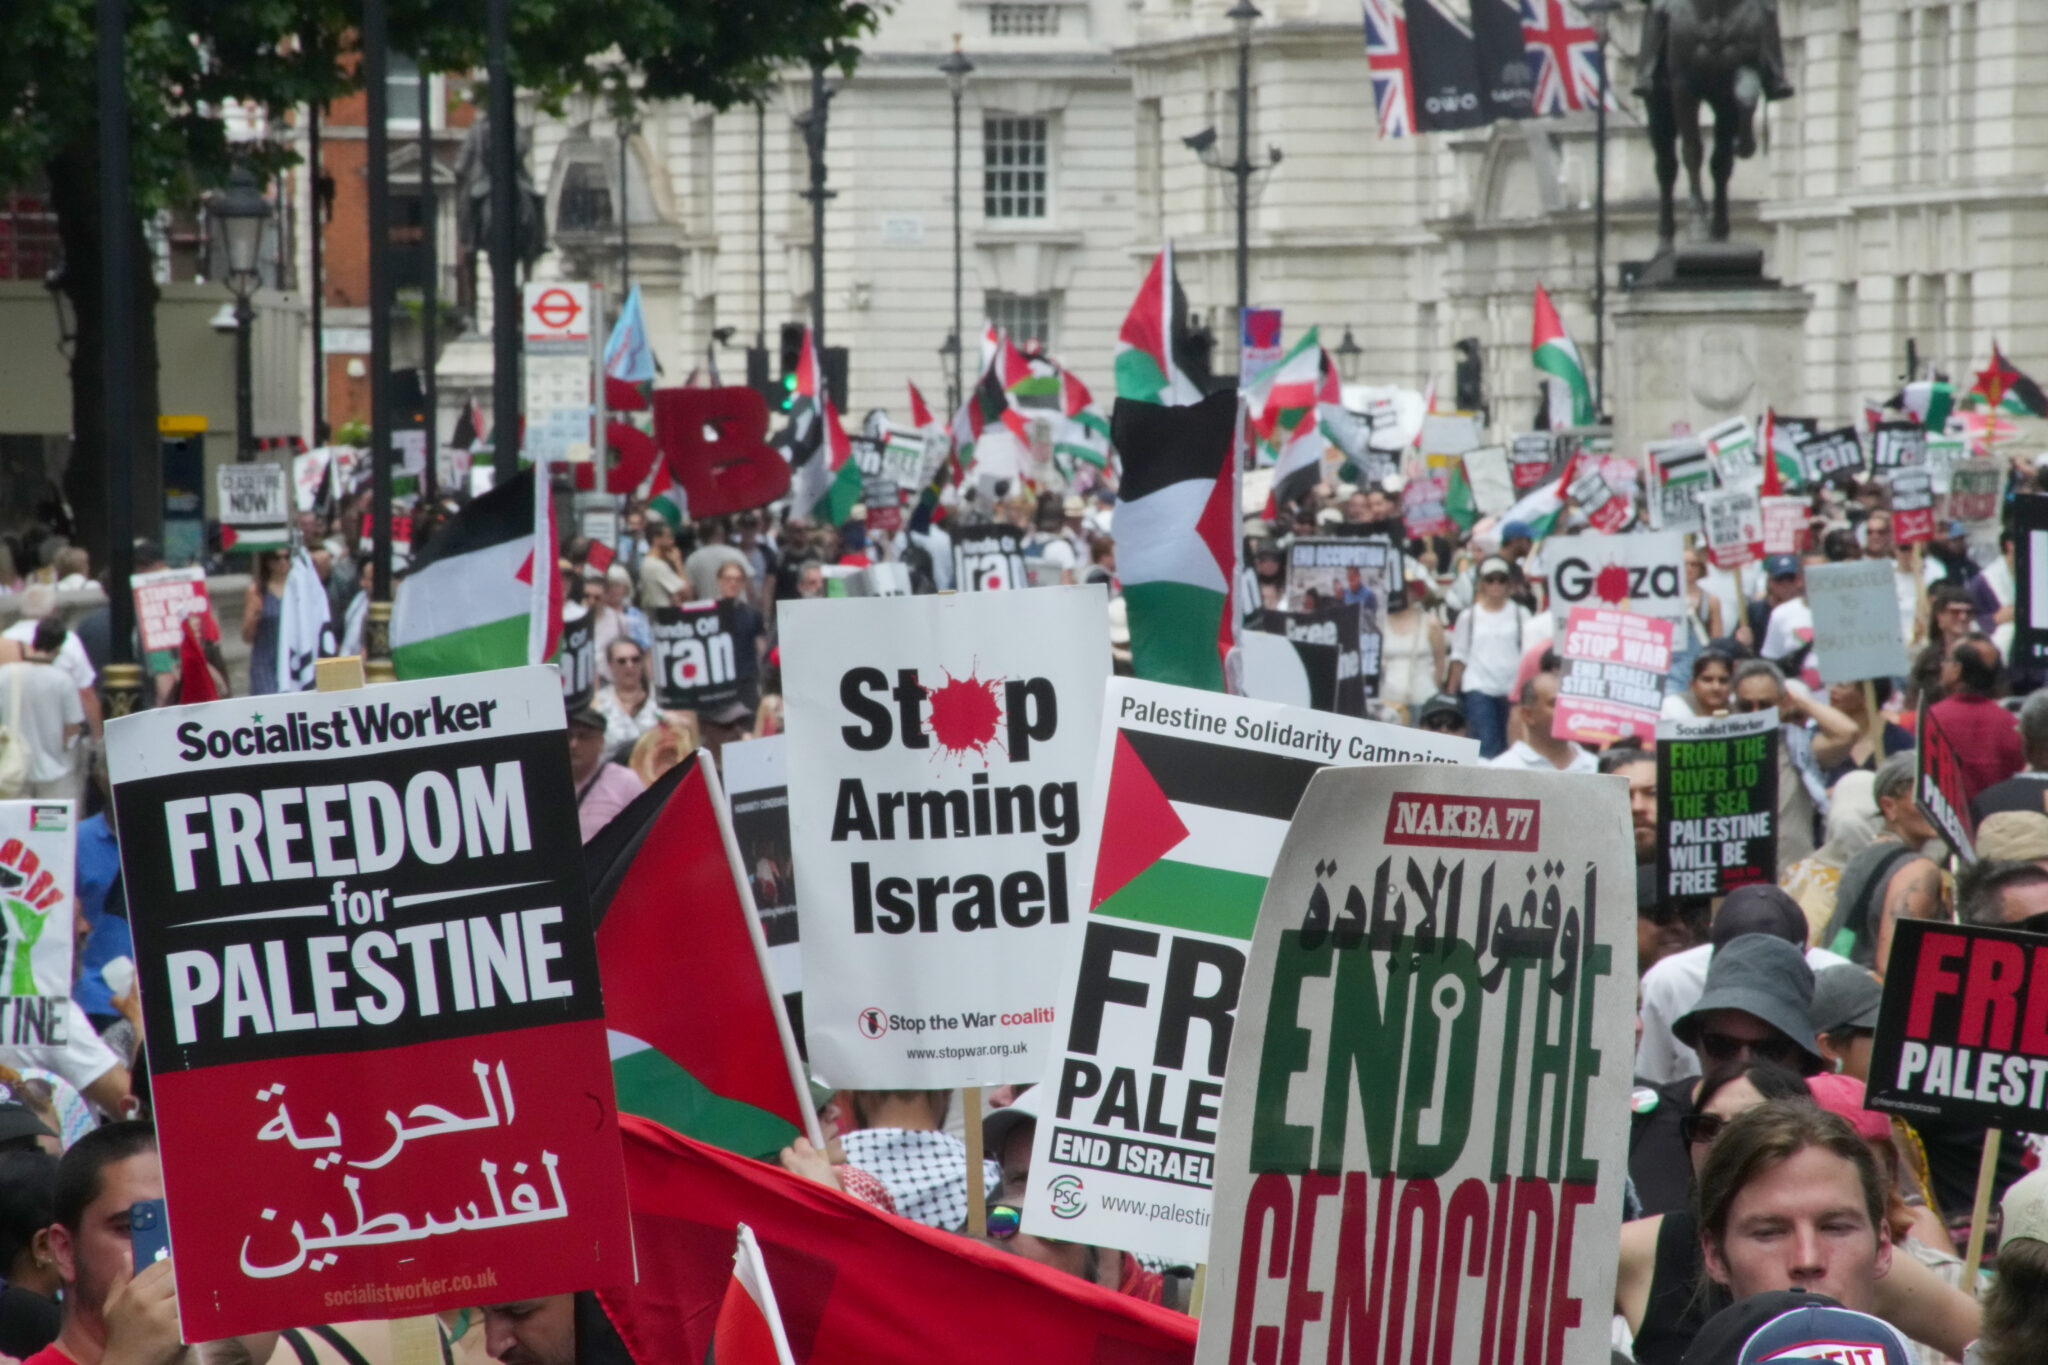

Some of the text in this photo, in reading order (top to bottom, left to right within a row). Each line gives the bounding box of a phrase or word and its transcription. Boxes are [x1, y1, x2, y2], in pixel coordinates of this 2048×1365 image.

[1554, 557, 1680, 602] Gza
[654, 632, 736, 689] ran
[1567, 632, 1668, 668] STOP WAR
[1562, 675, 1606, 698] STATE
[839, 665, 1058, 763] Stp
[1120, 695, 1227, 736] Palestine
[1233, 716, 1342, 759] Solidarity
[1669, 735, 1766, 767] FROM THE
[1670, 763, 1758, 793] RIVER TO
[830, 772, 1081, 847] Arming
[1393, 801, 1534, 841] NAKBA 77
[1672, 790, 1749, 818] THE SEA
[164, 760, 532, 892] FREEDOM
[1669, 811, 1771, 845] PALESTINE
[1669, 840, 1747, 870] WILL BE
[330, 880, 389, 926] for
[850, 851, 1070, 934] Israel
[1668, 869, 1717, 896] FREE
[165, 906, 574, 1045] PALESTINE
[889, 1014, 927, 1033] Stop
[929, 1015, 959, 1030] the
[962, 1011, 997, 1028] War
[906, 1041, 1028, 1061] www.stopwar.org.uk
[1249, 929, 1613, 1185] END THE
[256, 1058, 517, 1170] الحرية
[1053, 1132, 1111, 1167] END
[239, 1149, 569, 1279] لفلسطين
[1053, 1188, 1081, 1207] PSC
[324, 1266, 498, 1307] socialistworker.co.uk
[1228, 1169, 1599, 1365] GENOCIDE
